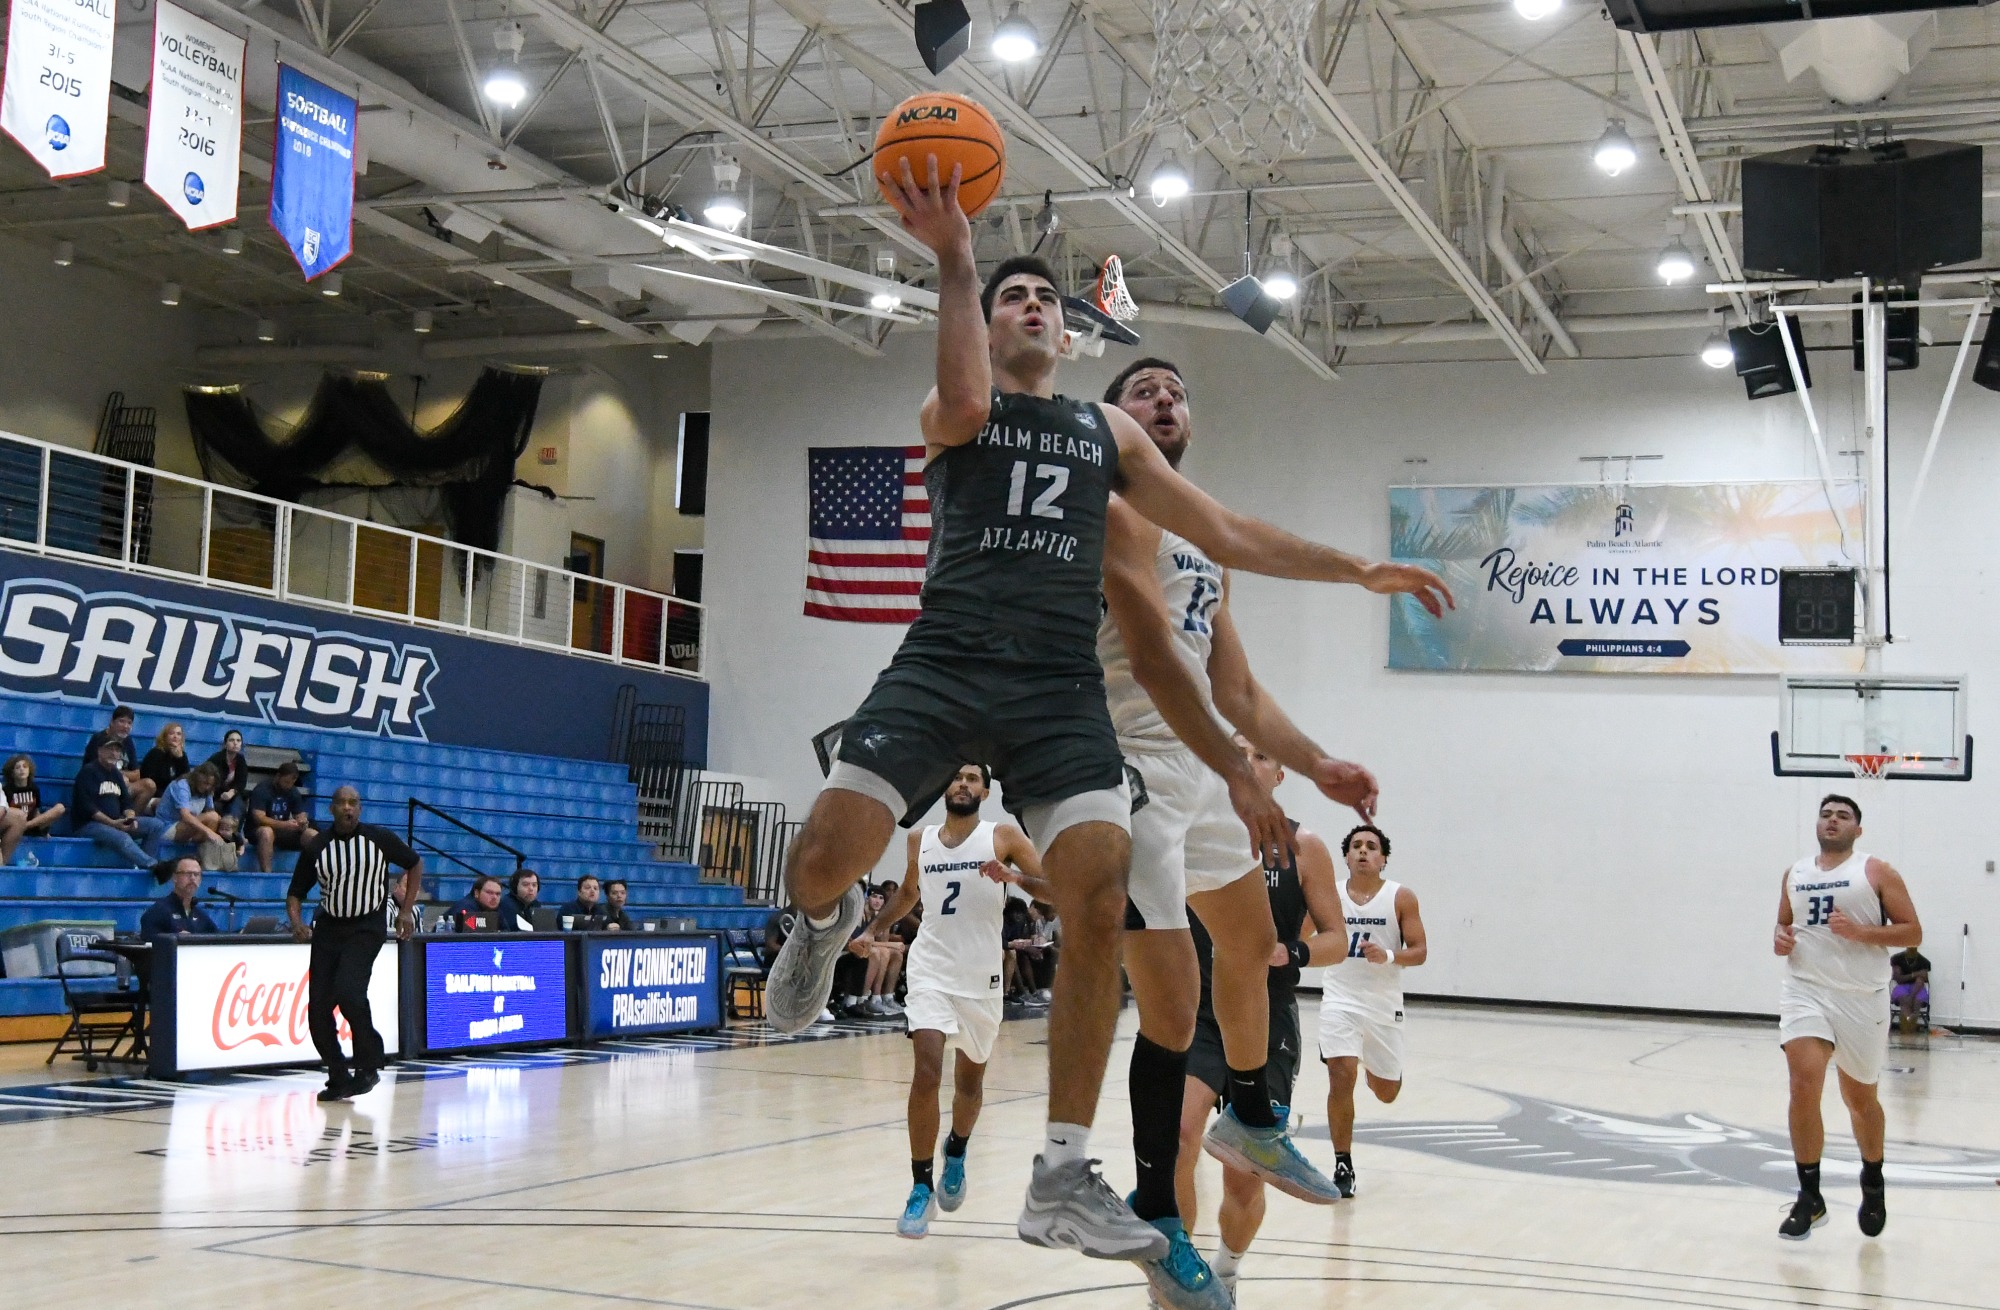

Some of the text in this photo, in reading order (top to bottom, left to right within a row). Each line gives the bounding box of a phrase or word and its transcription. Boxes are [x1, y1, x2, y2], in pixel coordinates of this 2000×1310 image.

[48, 43, 76, 65] 31-5
[160, 31, 238, 83] VOLLEYBALL
[39, 65, 82, 98] 2015
[160, 59, 177, 74] NCAA
[178, 69, 206, 87] National
[287, 91, 347, 136] SOFTBALL
[896, 105, 958, 128] NCAA
[178, 126, 216, 156] 2016
[292, 138, 312, 158] 2018
[977, 422, 1103, 467] PALM BEACH
[1006, 460, 1070, 520] 12
[979, 527, 1078, 562] ATLANTIC
[1586, 540, 1606, 548] Palm
[1608, 540, 1631, 548] Beach
[1480, 547, 1778, 604] Rejoice IN THE LORD
[1529, 597, 1721, 625] ALWAYS
[0, 592, 428, 724] SAILFISH
[1585, 644, 1662, 654] PHILIPPIANS 4:4
[941, 881, 961, 915] 2
[1795, 880, 1850, 892] VAQUEROS
[1807, 895, 1834, 926] 33
[1348, 931, 1371, 957] 11
[600, 947, 707, 989] STAY CONNECTED!
[612, 991, 698, 1028] PBAsailfish.com
